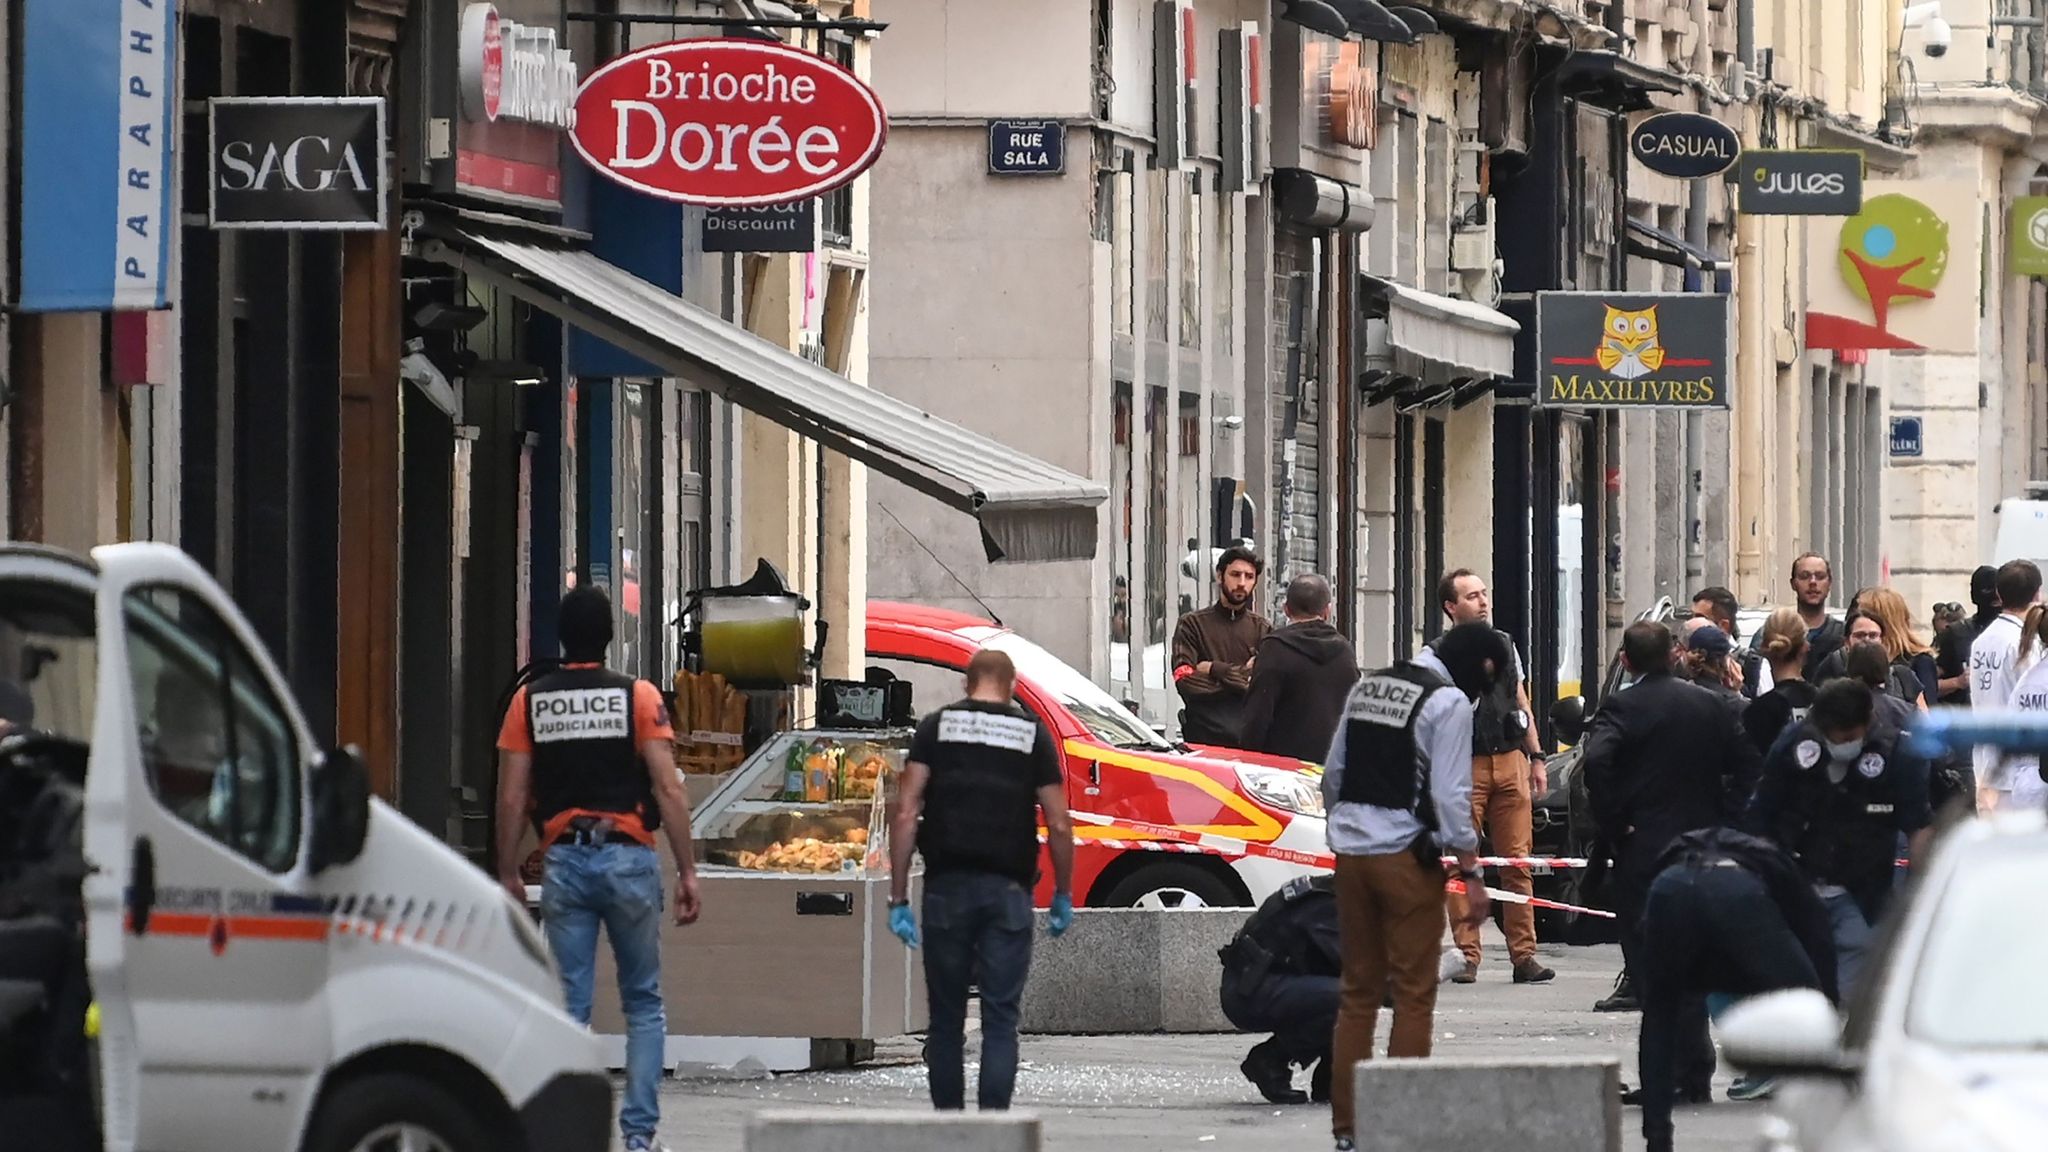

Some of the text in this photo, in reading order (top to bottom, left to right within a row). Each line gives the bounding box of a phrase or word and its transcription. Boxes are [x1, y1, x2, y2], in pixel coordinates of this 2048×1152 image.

[646, 58, 816, 104] Brioche
[608, 98, 840, 175] Dorée
[1010, 133, 1043, 147] RUE
[1638, 133, 1730, 158] CASUAL
[220, 135, 372, 192] SAGA
[1003, 151, 1049, 165] SALA
[707, 216, 796, 230] Discount
[1550, 374, 1714, 402] MAXILIVRES
[1354, 682, 1416, 704] POLICE
[535, 696, 623, 717] POLICE
[537, 718, 623, 733] JUDICIAIRE
